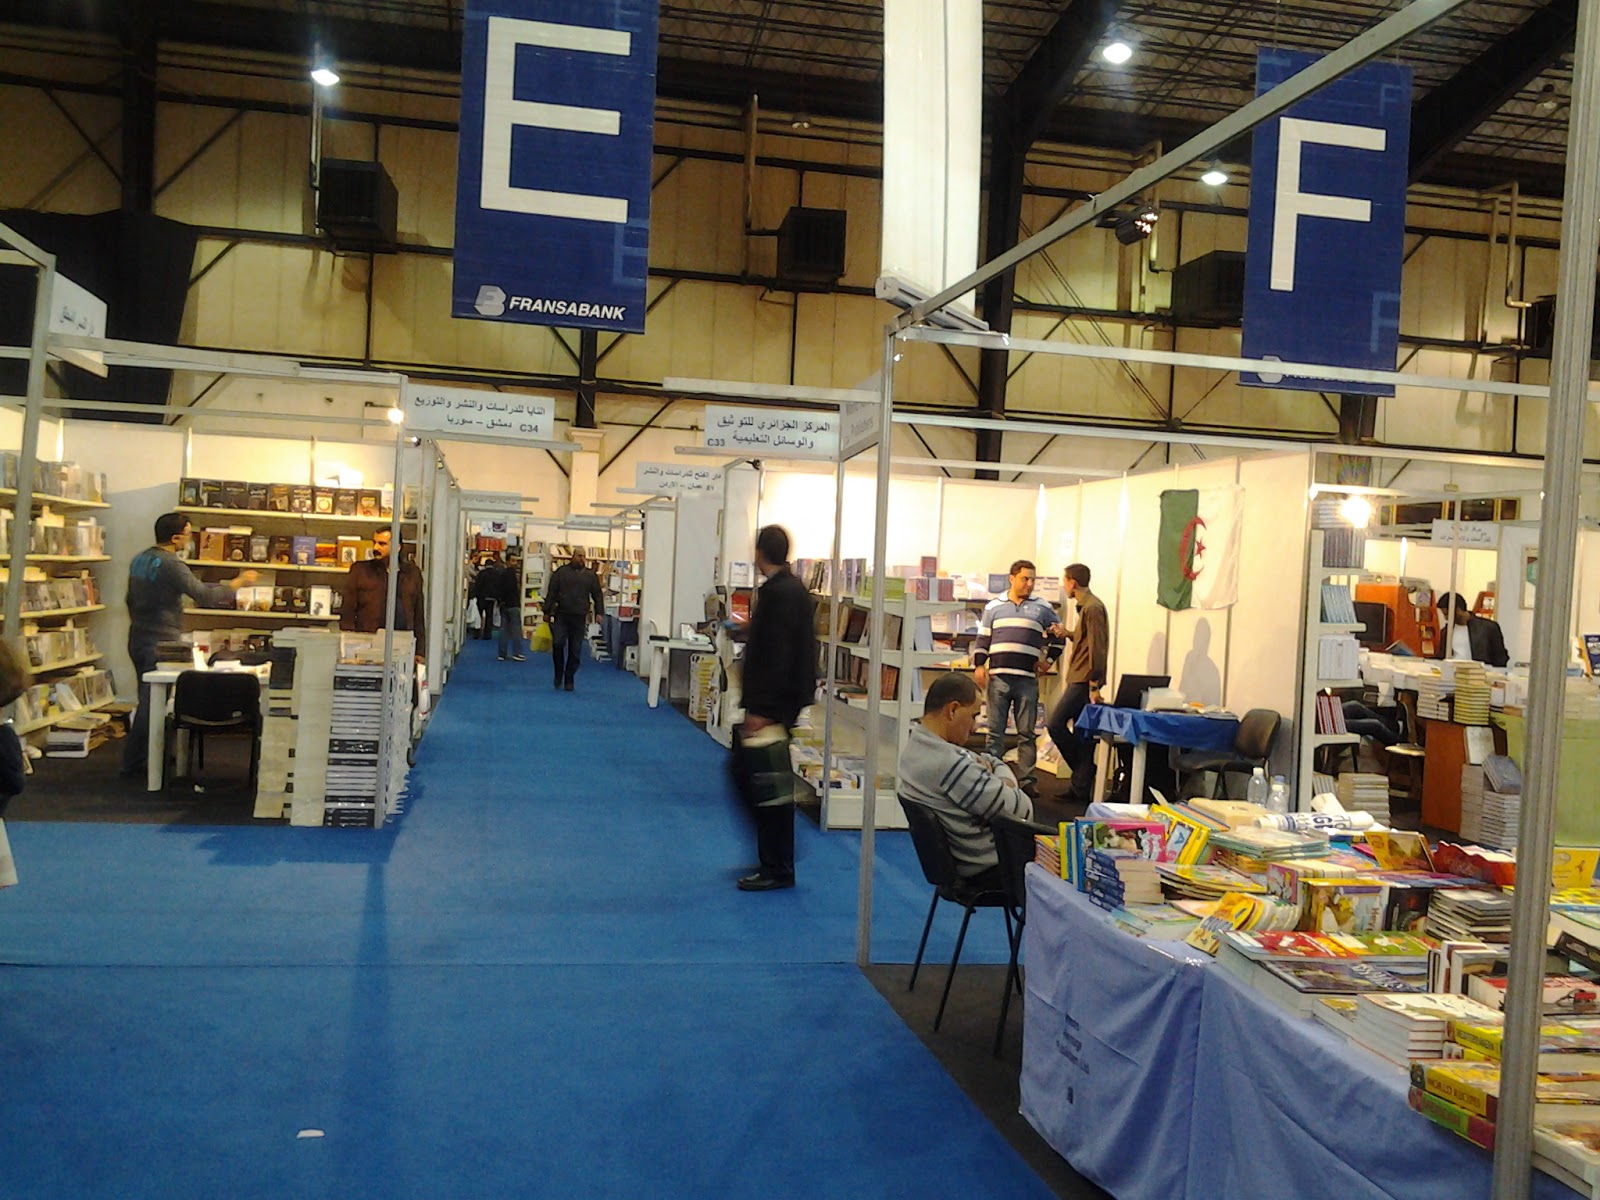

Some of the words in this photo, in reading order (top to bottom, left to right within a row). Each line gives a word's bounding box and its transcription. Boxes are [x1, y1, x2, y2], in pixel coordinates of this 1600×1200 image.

[480, 15, 632, 224] E
[1269, 116, 1386, 292] F
[509, 296, 626, 321] FRANSABANK
[414, 396, 452, 408] والتوزيع
[455, 399, 483, 412] والنشر
[486, 402, 524, 415] للدراسات
[446, 414, 473, 425] سوريا
[486, 418, 512, 429] دمشق
[757, 419, 798, 431] الجزائري
[519, 424, 539, 433] C34
[803, 421, 831, 433] المركز
[707, 438, 725, 447] C33
[732, 430, 770, 446] التعليمية
[773, 435, 814, 449] والوسائل
[643, 467, 664, 476] والنشر
[711, 473, 722, 481] دار
